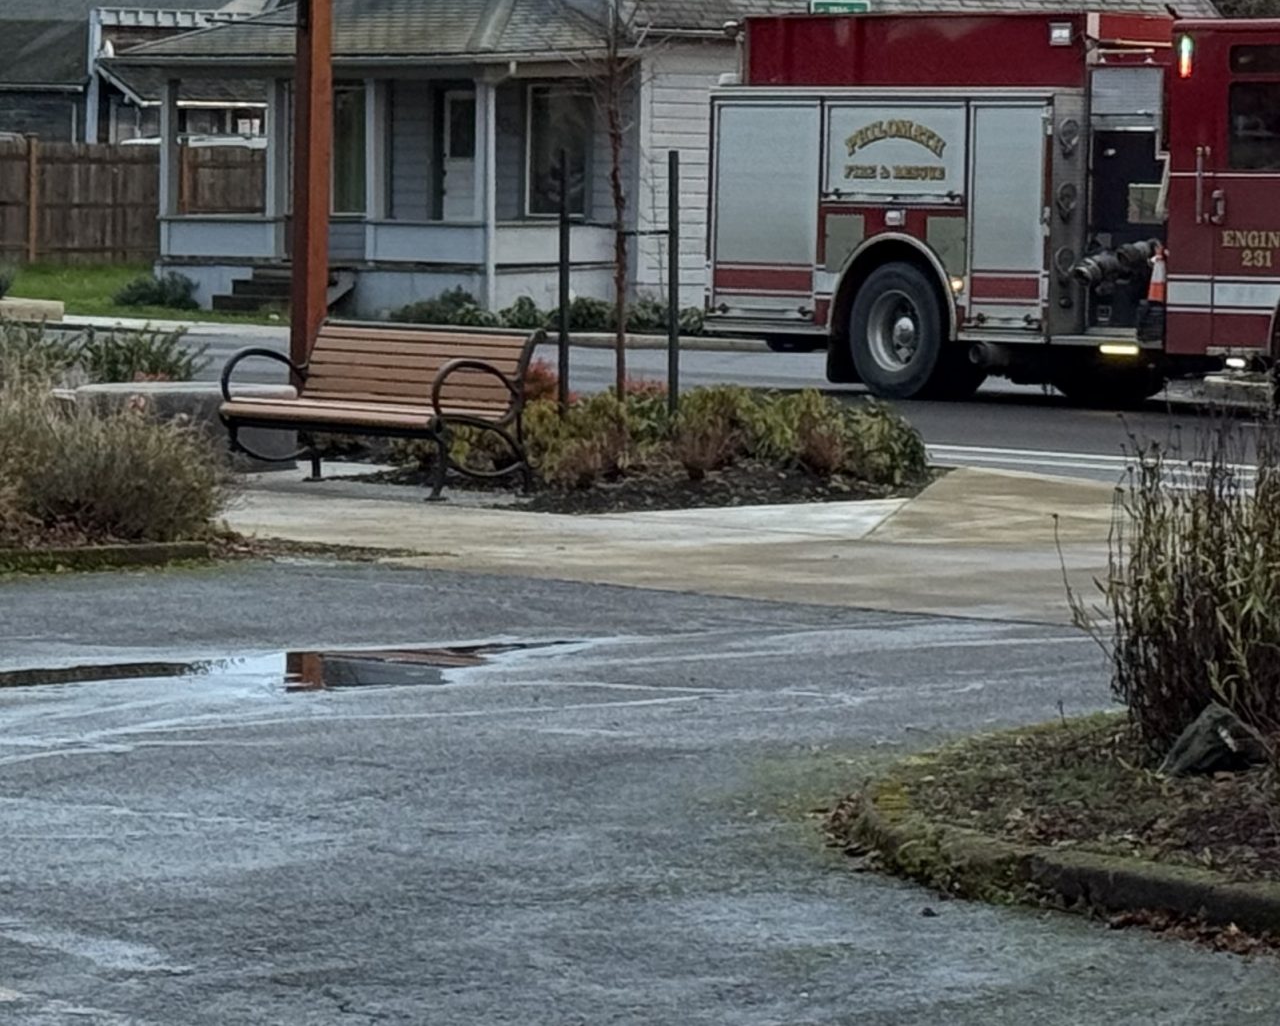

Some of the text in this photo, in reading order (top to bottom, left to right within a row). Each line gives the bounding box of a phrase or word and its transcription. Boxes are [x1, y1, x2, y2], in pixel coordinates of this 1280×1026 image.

[844, 119, 946, 159] PHILOMATH
[844, 165, 946, 181] FIRE & RESCUE
[1241, 249, 1272, 267] 231
